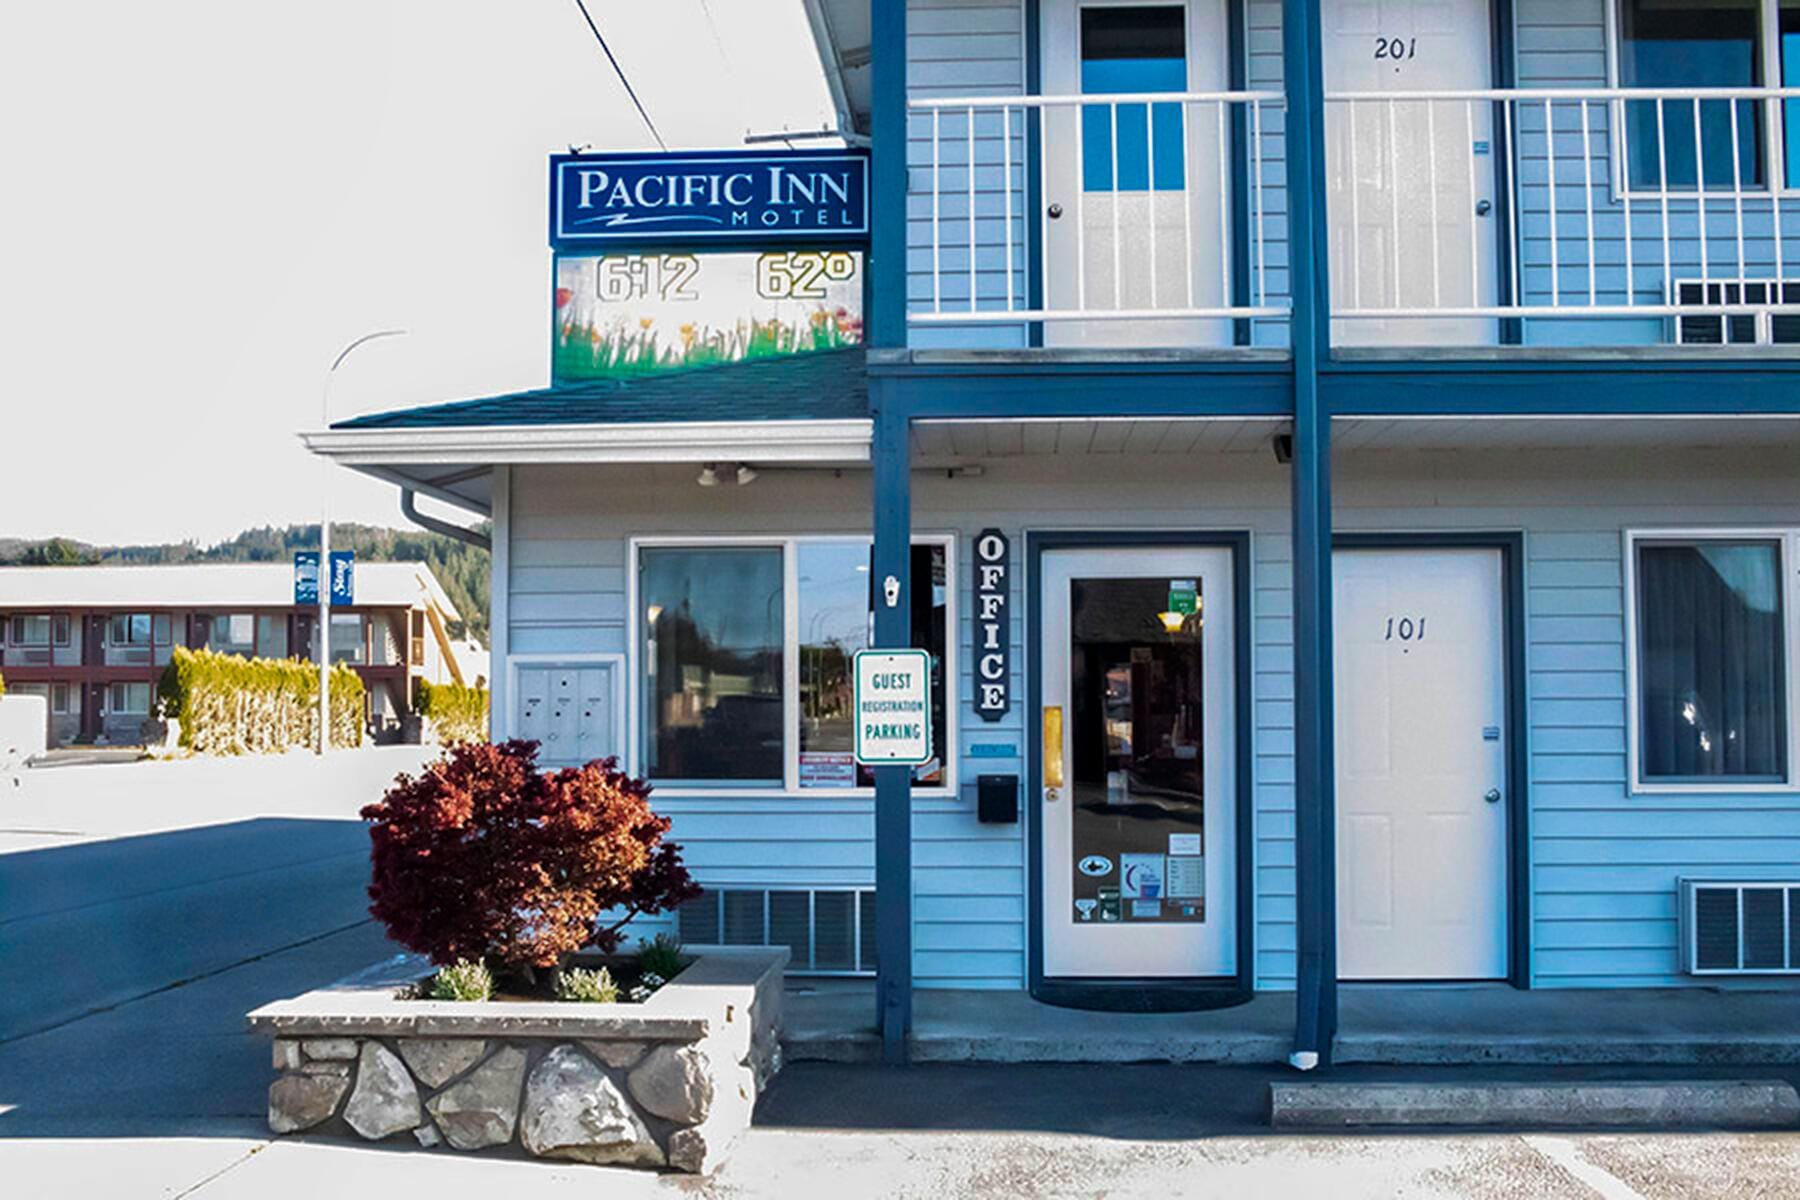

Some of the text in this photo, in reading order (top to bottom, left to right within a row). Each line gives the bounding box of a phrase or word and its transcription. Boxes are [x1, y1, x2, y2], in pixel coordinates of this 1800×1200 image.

[1374, 37, 1416, 60] 201
[576, 166, 850, 209] PACIFIC INN
[732, 209, 853, 226] MOTEL
[979, 535, 1005, 711] OFFICE
[1385, 617, 1426, 641] 101
[872, 673, 912, 690] GUEST
[861, 700, 923, 713] REGISTRATION
[865, 724, 921, 740] PARKING
